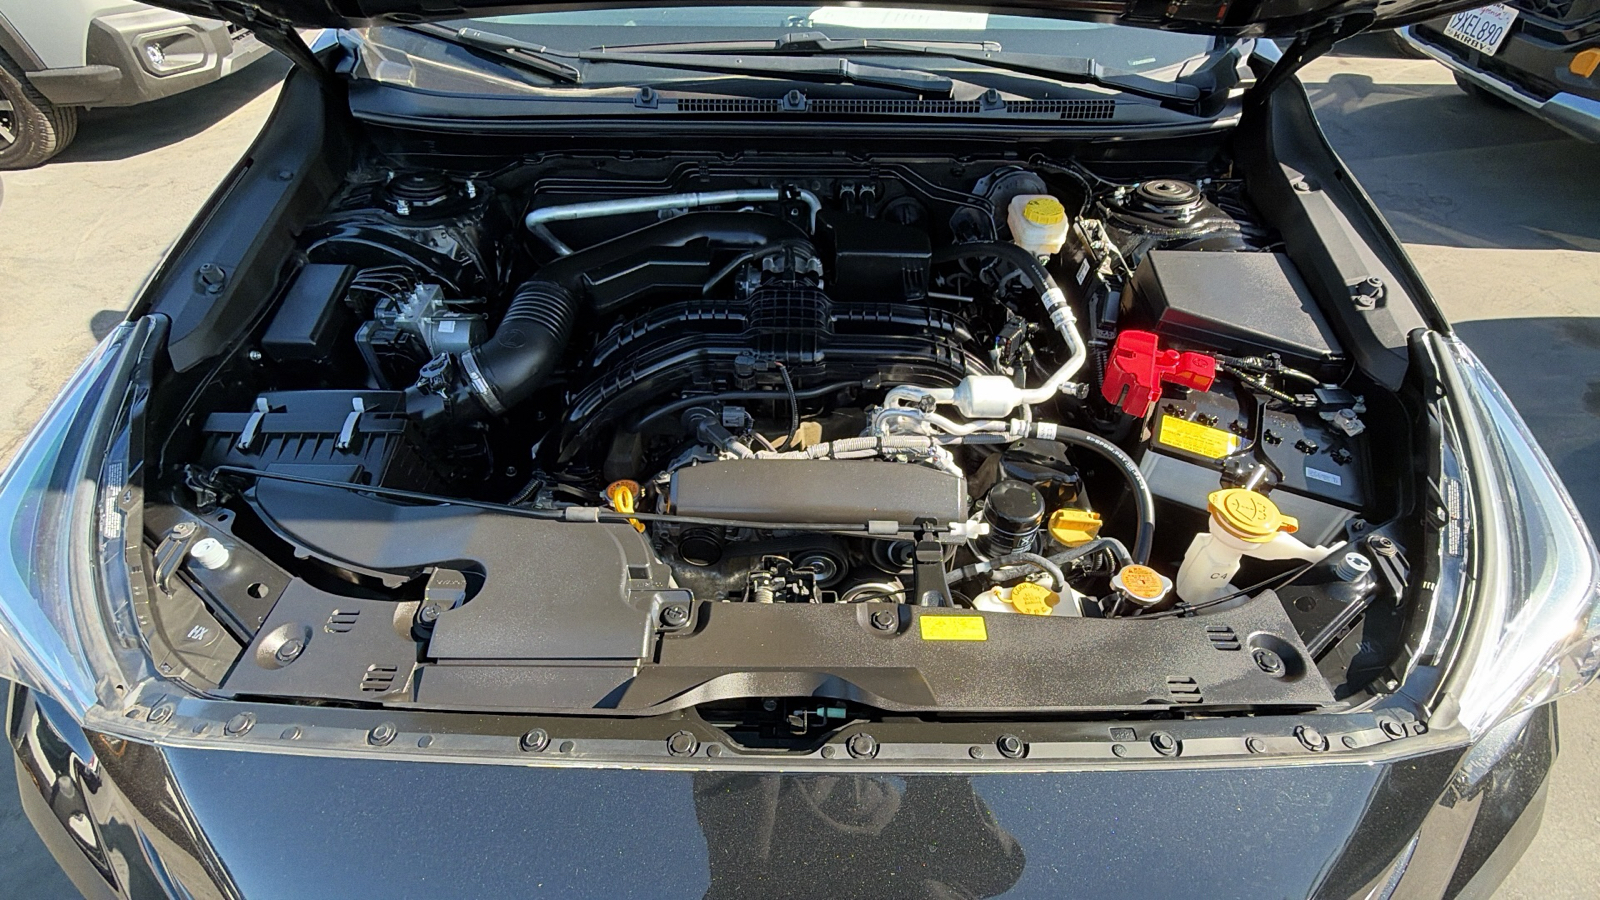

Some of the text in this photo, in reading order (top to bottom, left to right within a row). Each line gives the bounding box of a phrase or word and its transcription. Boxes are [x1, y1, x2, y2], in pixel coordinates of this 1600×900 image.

[1451, 12, 1503, 46] 9XEL890
[1453, 31, 1487, 50] KIRBY
[187, 624, 209, 641] HX
